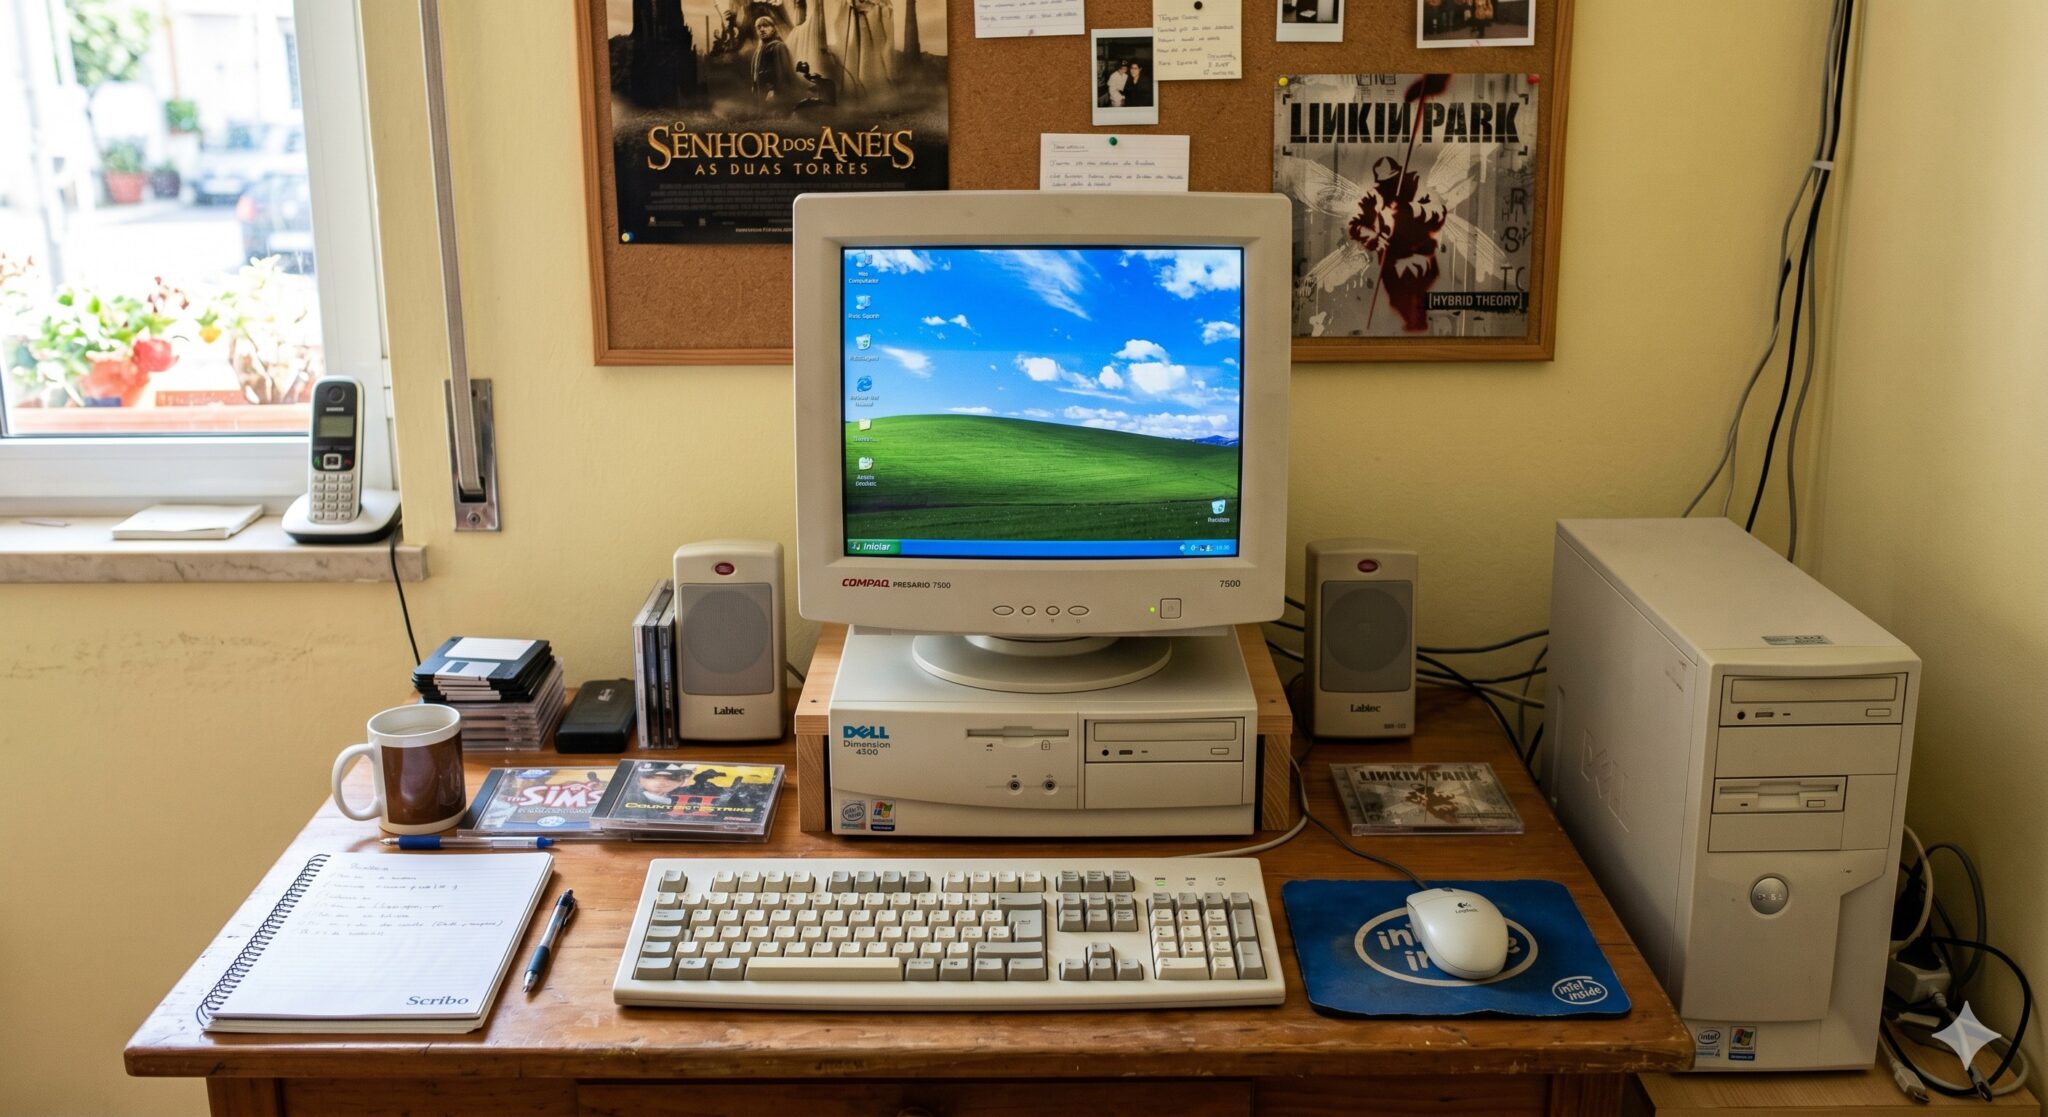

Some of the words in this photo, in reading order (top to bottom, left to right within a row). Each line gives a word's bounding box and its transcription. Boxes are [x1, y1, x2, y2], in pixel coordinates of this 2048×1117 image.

[674, 121, 686, 132] O
[1290, 102, 1411, 144] LINKIN
[1422, 102, 1521, 144] PARK
[647, 124, 784, 171] SENHOR
[782, 138, 816, 152] DOS
[813, 124, 915, 170] ANÉIS
[694, 163, 719, 175] AS
[730, 163, 782, 175] DUAS
[793, 163, 869, 175] TORRES
[842, 578, 890, 588] COMPAQ
[892, 581, 930, 589] PRESARIO
[1219, 580, 1241, 588] 7500
[714, 706, 745, 715] Labtec
[1350, 704, 1381, 712] Labtec
[843, 725, 890, 739] DELL
[843, 740, 891, 749] Dimension
[1359, 770, 1426, 782] LINKIN
[1428, 770, 1482, 782] PARK
[518, 784, 605, 808] SIMS
[1558, 980, 1585, 995] intel
[1569, 986, 1602, 1001] inside
[406, 994, 469, 1006] Scribo
